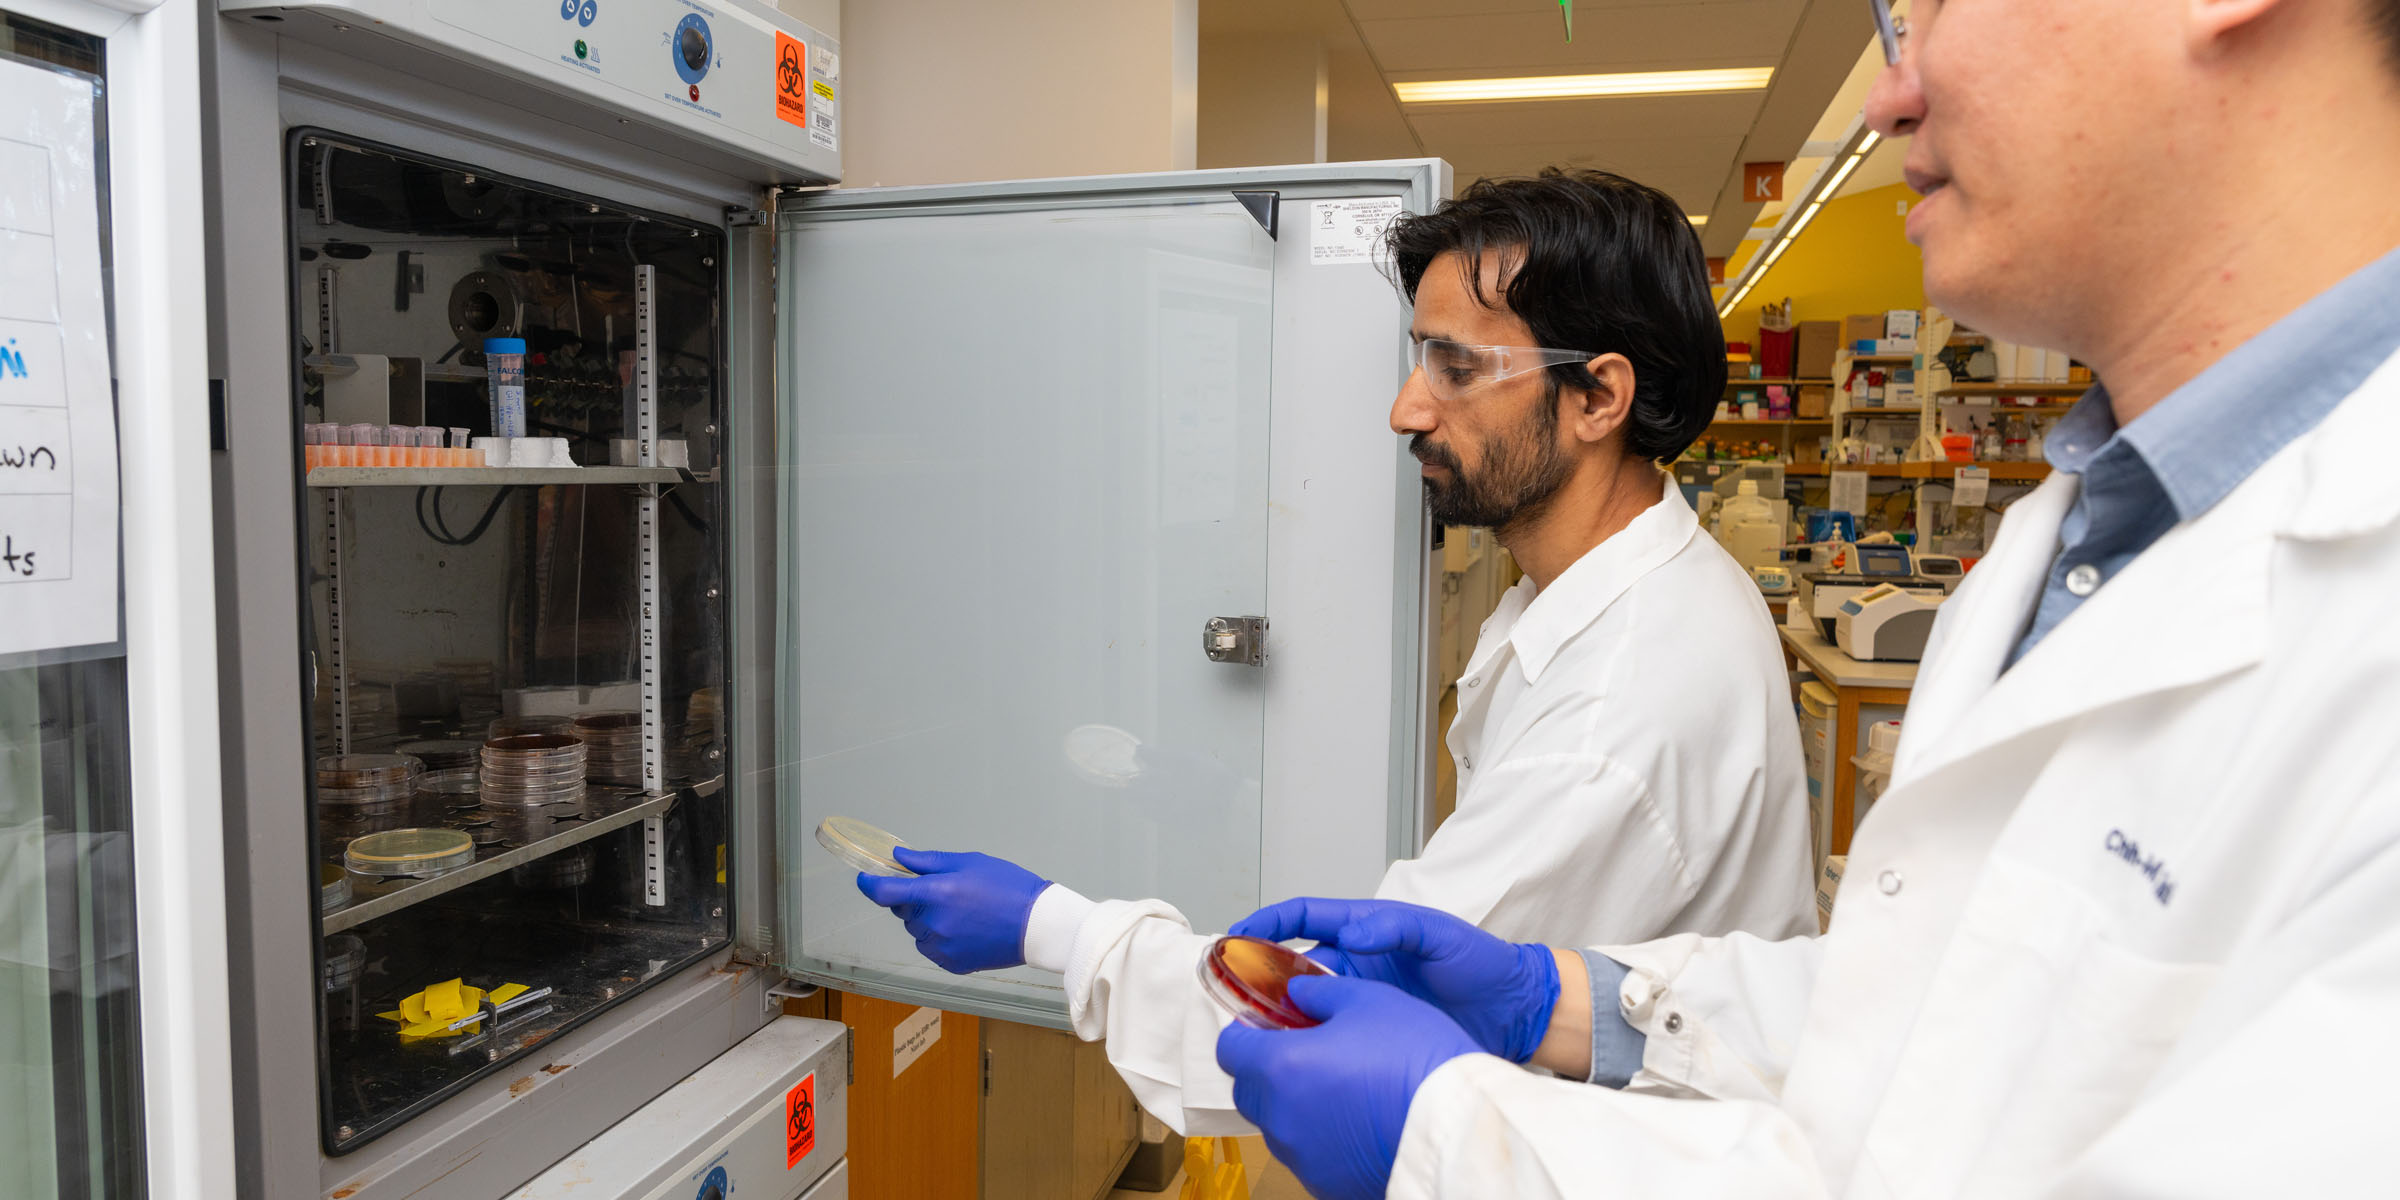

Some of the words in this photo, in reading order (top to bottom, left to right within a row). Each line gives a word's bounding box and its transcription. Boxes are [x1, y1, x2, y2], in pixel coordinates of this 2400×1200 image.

[561, 55, 577, 65] HEATING
[578, 61, 600, 74] ACTIVATED
[681, 98, 704, 112] TEMPERATURE
[704, 108, 721, 118] ACTIVATED
[779, 94, 803, 114] BIOHAZARD
[1756, 175, 1772, 198] K
[789, 1129, 812, 1156] BIOHAZARD
